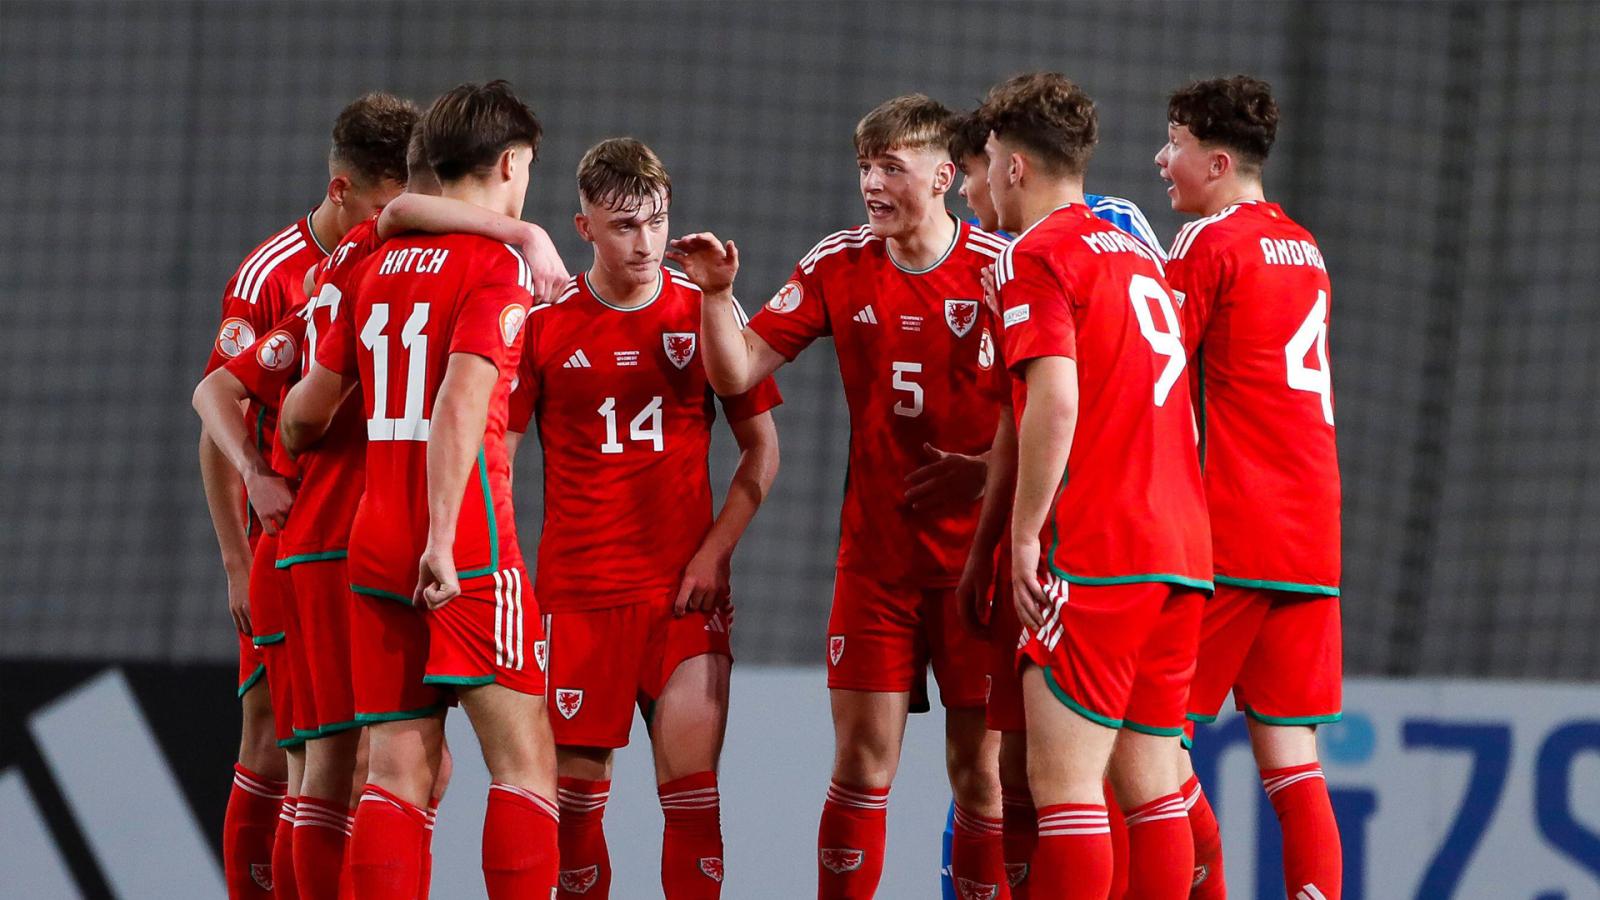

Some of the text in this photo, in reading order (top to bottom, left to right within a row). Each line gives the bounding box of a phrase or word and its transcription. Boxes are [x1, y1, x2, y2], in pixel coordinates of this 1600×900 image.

[379, 248, 449, 275] HATCH
[360, 302, 431, 441] 11
[1129, 274, 1187, 407] 9
[1285, 289, 1334, 426] 4
[597, 396, 664, 453] 14
[892, 361, 924, 418] 5
